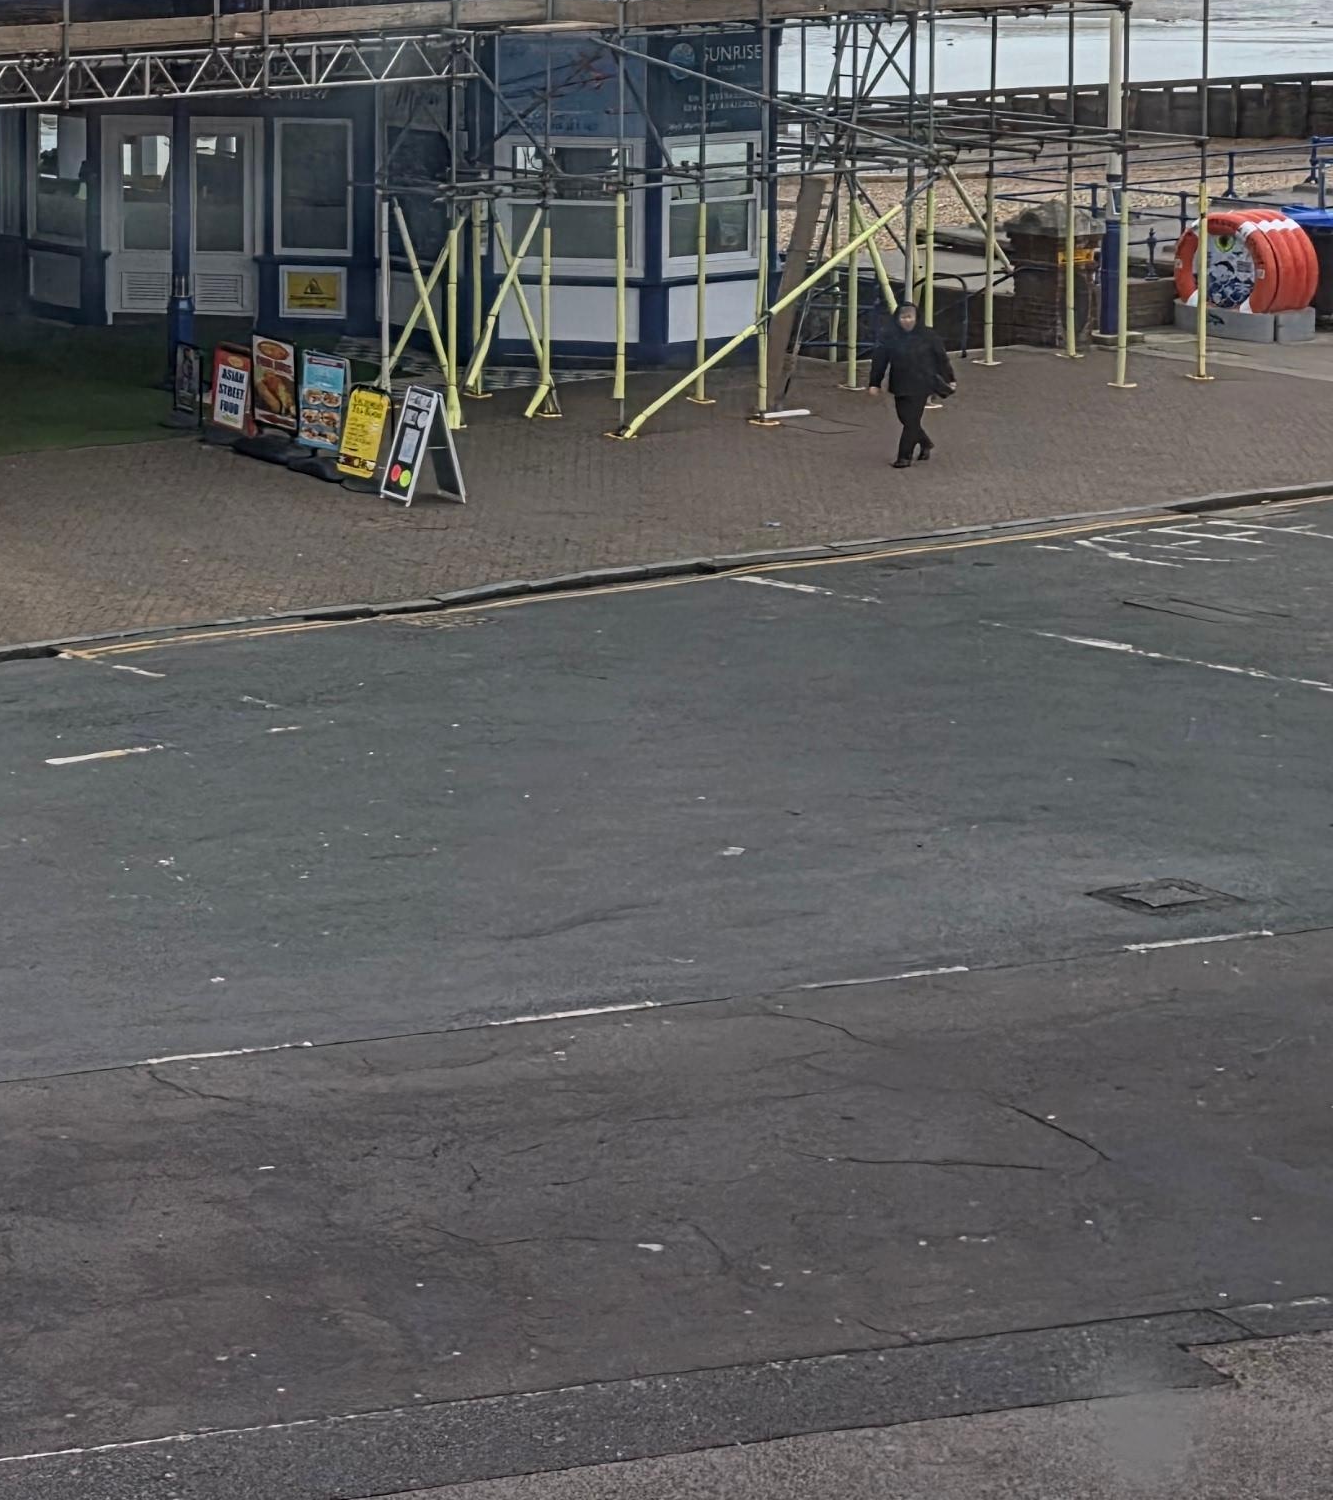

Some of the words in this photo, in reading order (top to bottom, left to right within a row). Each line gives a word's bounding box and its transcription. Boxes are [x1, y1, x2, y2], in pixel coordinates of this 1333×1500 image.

[704, 44, 762, 62] SUNRISE
[221, 368, 245, 384] ASIAN
[218, 383, 245, 400] STREET
[220, 399, 239, 415] FOOD
